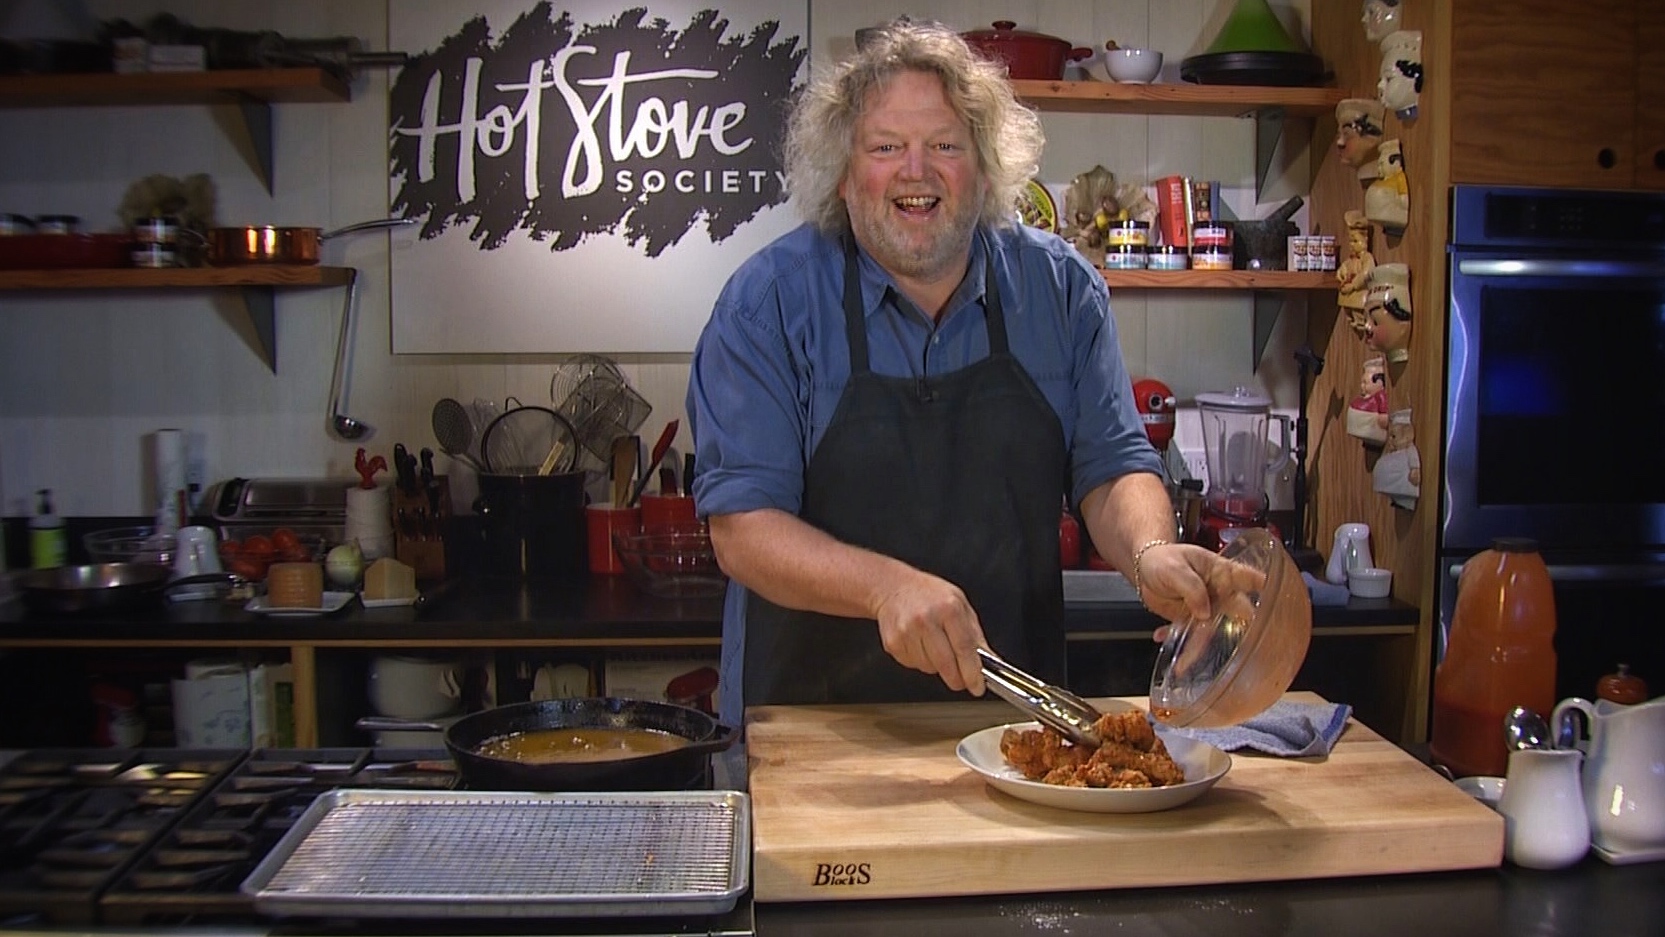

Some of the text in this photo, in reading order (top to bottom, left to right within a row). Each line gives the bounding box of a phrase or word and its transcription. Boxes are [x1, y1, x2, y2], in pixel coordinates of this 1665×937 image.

[396, 45, 754, 204] Hot Stove
[616, 169, 791, 194] SOCIETY
